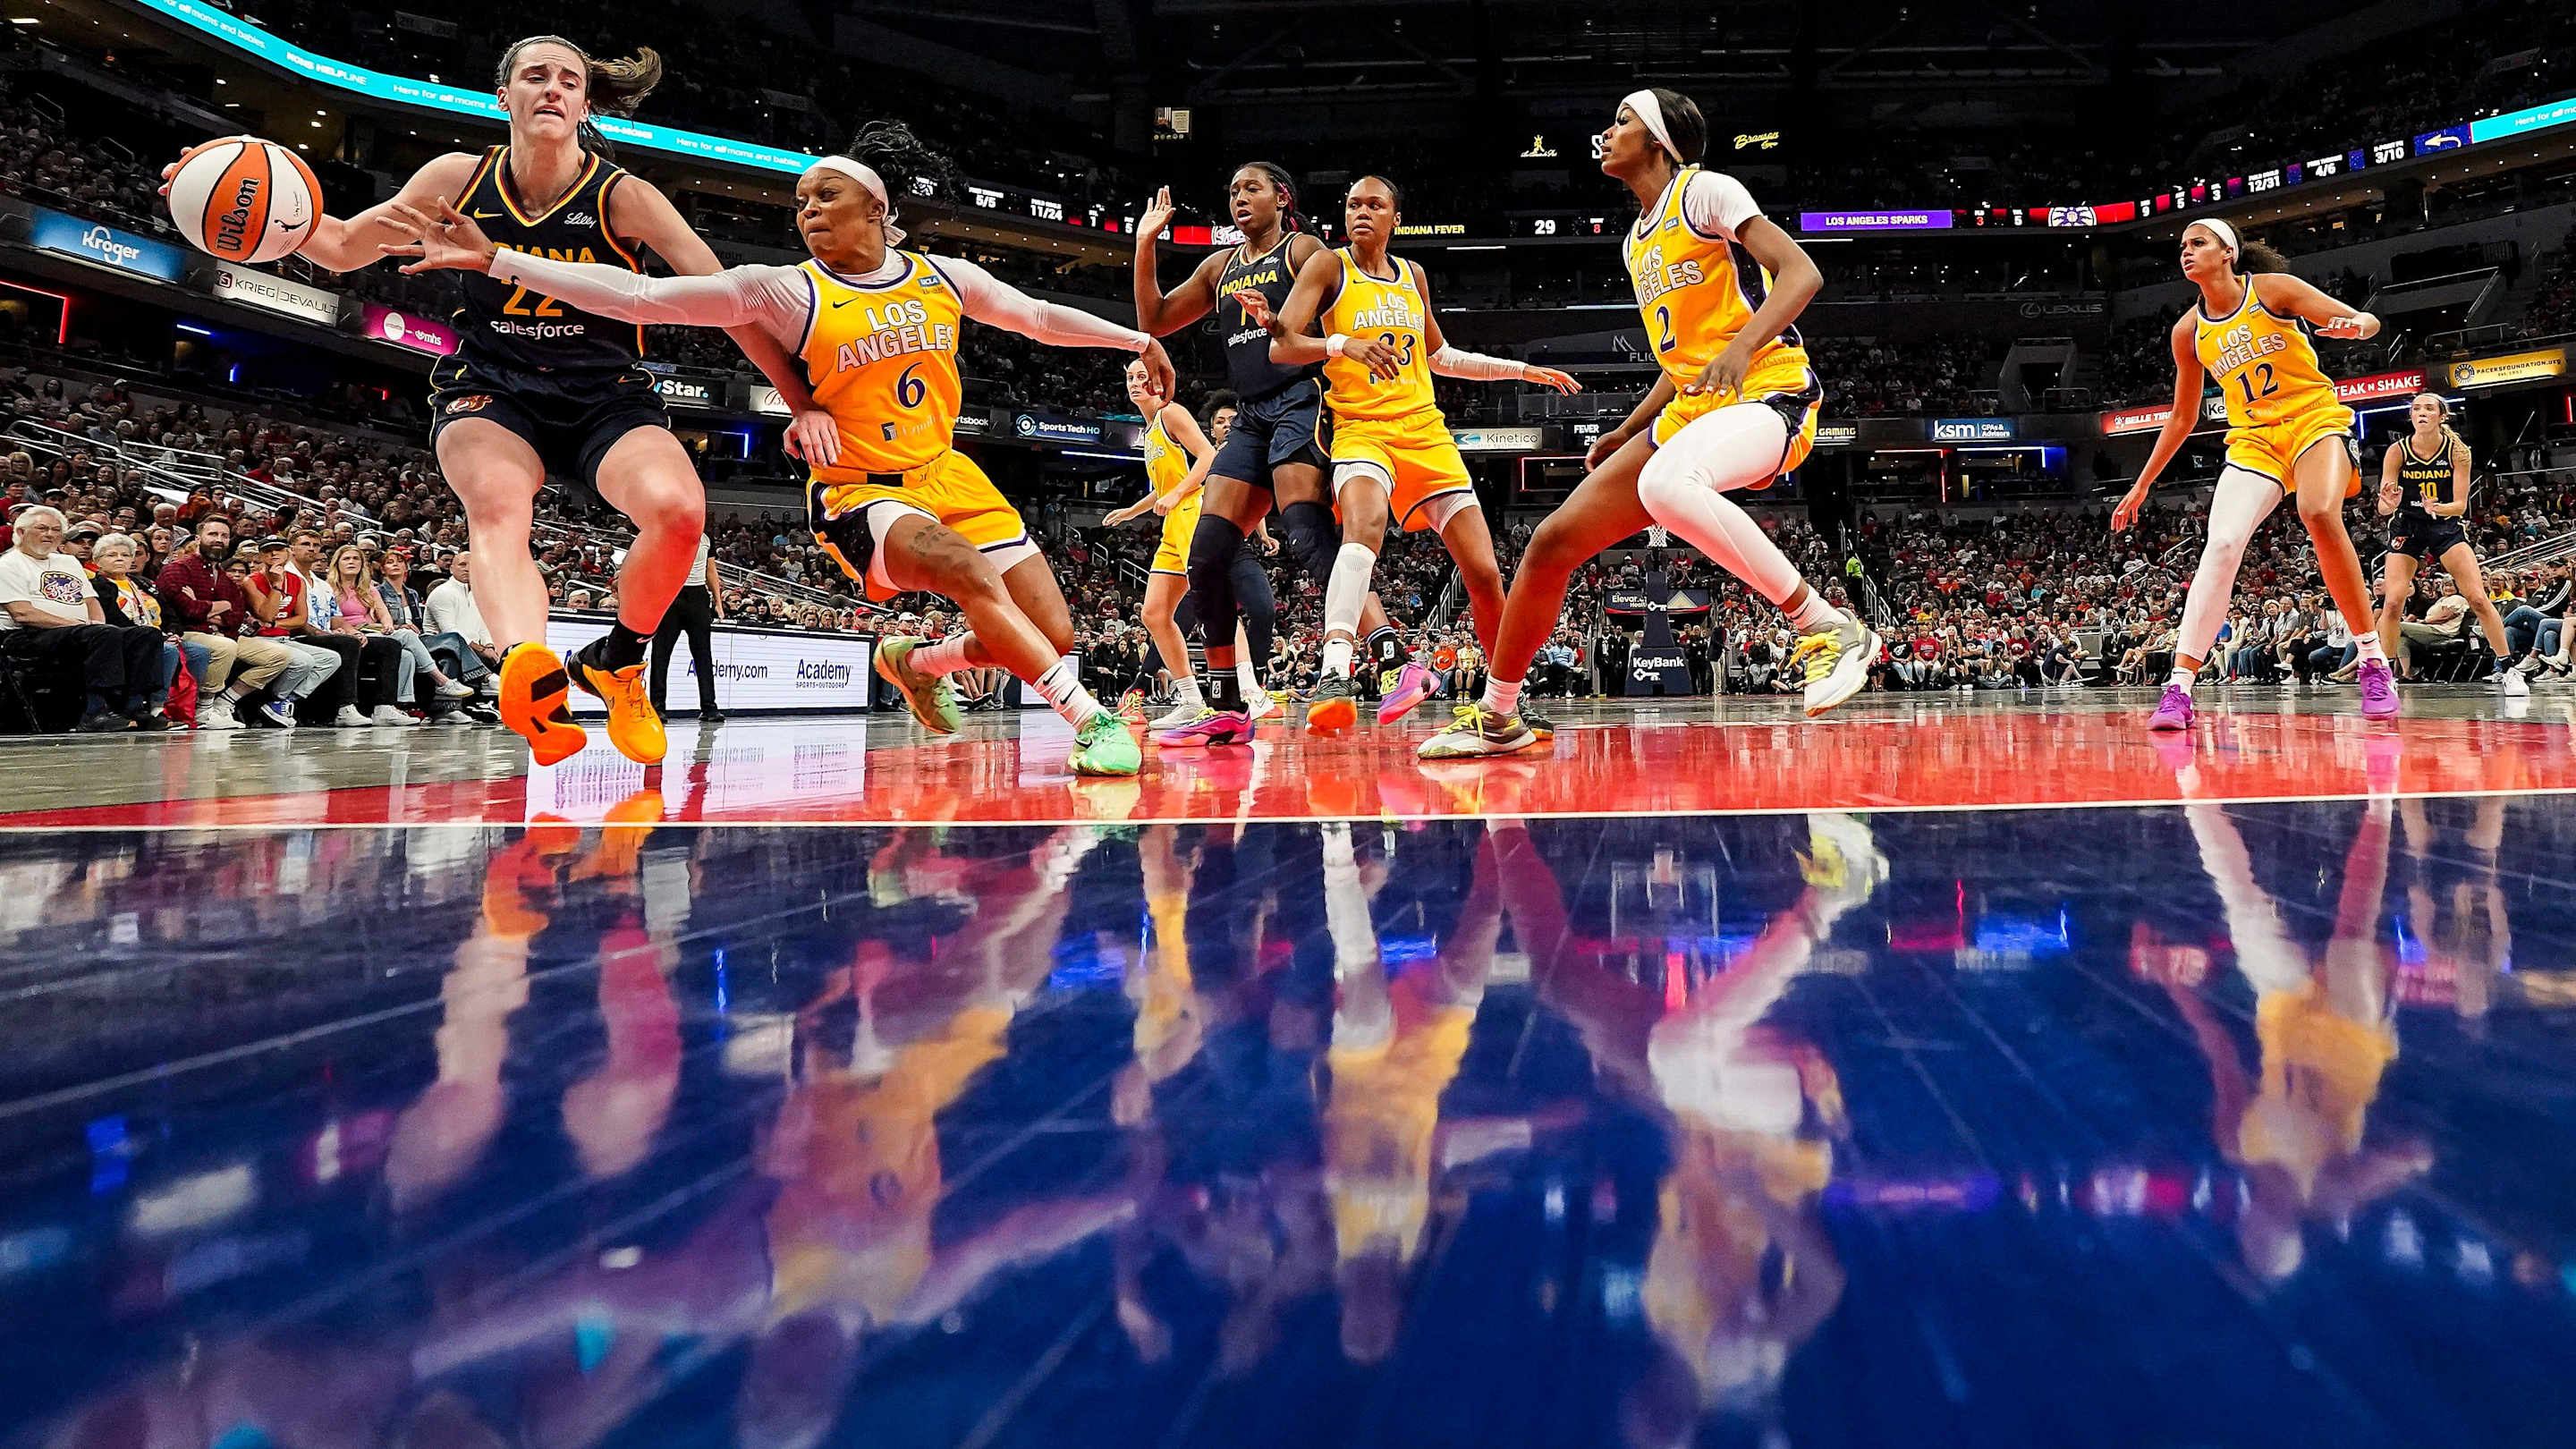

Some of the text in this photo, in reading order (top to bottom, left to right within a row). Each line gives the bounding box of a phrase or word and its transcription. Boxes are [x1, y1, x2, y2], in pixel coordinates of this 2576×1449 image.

[316, 63, 368, 86] HELPLINE
[393, 84, 420, 97] Here
[421, 89, 437, 99] for
[454, 97, 486, 110] moms
[2514, 115, 2537, 127] Here
[2538, 112, 2550, 122] for
[675, 136, 699, 149] Here
[699, 141, 713, 152] for
[726, 148, 754, 160] moms
[755, 153, 772, 164] and
[2375, 146, 2405, 165] 3/10
[2315, 162, 2336, 177] 4/6
[2248, 175, 2280, 193] 12/31
[975, 193, 996, 208] 5/5
[2212, 189, 2221, 201] 3
[216, 176, 261, 252] Wilson
[1030, 204, 1063, 222] 11/24
[2141, 206, 2151, 217] 9
[2176, 199, 2185, 211] 5
[564, 212, 597, 229] Lilly
[1089, 216, 1097, 227] 1
[1124, 222, 1133, 234] 5
[1394, 225, 1465, 235] INDIANA FEVER
[1534, 219, 1556, 235] 29
[1593, 223, 1602, 234] 8
[1825, 215, 1928, 226] LOS ANGELES SPARKS
[1976, 216, 1984, 226] 3
[2013, 216, 2023, 226] 5
[80, 225, 141, 266] Kroger
[1634, 244, 1664, 283] LOS
[1220, 269, 1279, 299] INDIANA
[1634, 258, 1705, 313] NGELES
[234, 277, 276, 299] KRIEG
[278, 290, 339, 316] DEVAULT
[1375, 292, 1410, 311] LOS
[865, 299, 928, 333] LOS
[490, 320, 585, 341] salesforce
[1227, 327, 1267, 348] salesforce
[1655, 304, 1677, 356] 2
[2216, 323, 2254, 353] LOS
[836, 323, 954, 371] ANGELES
[2209, 332, 2288, 379] ANGELES
[653, 378, 709, 399] Star.
[895, 361, 927, 411] 6
[2235, 361, 2279, 405] 12
[2332, 382, 2367, 399] TEAK
[2377, 374, 2422, 392] SHAKE
[955, 415, 989, 427] rtsbook
[1038, 421, 1101, 435] Sports Tech HQ
[1934, 419, 1976, 438] ksm
[2124, 412, 2152, 426] BELLE
[1487, 433, 1538, 443] Kinetico
[1573, 424, 1599, 434] FEVER
[1818, 427, 1857, 436] GAMING
[2402, 470, 2451, 479] INDIANA
[2419, 481, 2437, 500] 10
[687, 658, 767, 682] Ademy.com
[796, 658, 852, 686] Academy
[1632, 656, 1685, 670] KeyBank
